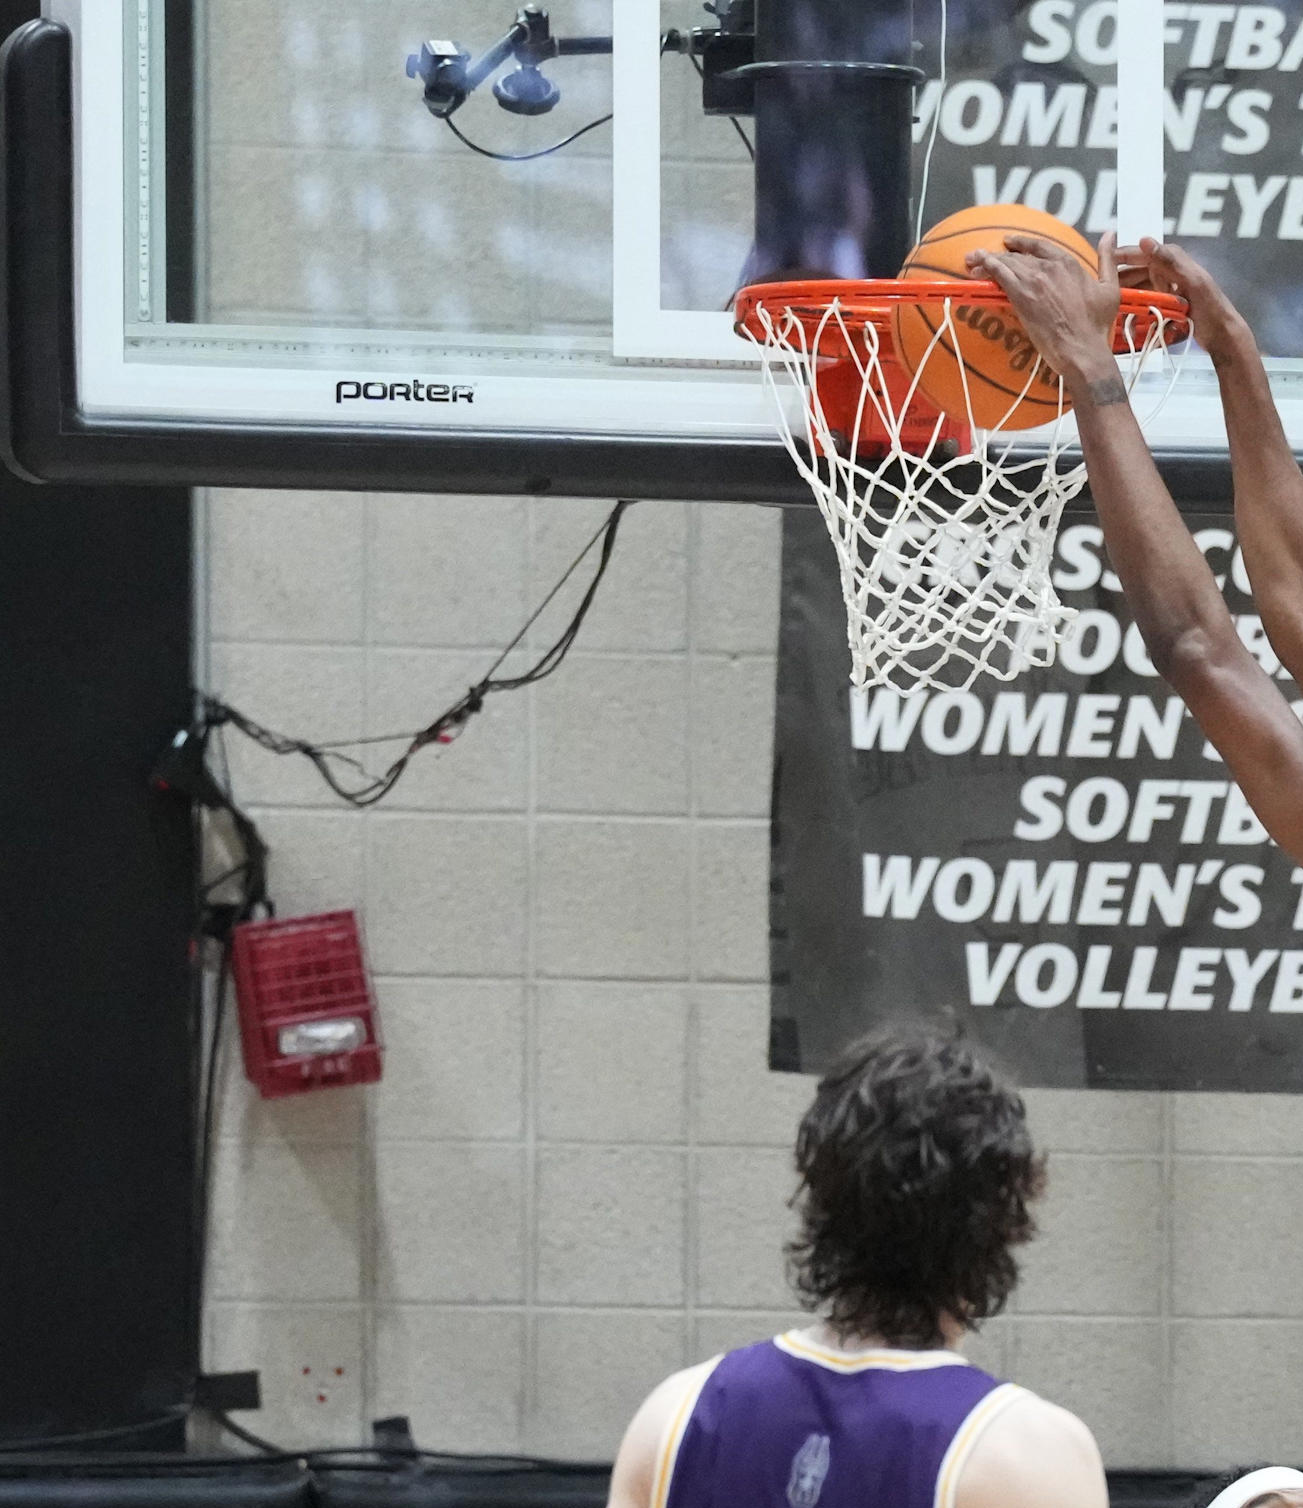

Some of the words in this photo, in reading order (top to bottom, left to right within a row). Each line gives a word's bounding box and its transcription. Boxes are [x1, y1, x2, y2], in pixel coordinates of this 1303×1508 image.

[878, 519, 1127, 593] CROS
[849, 687, 1222, 760] WOMEN
[1013, 774, 1278, 845] SOFTB
[862, 852, 1265, 930] WOMEN'S
